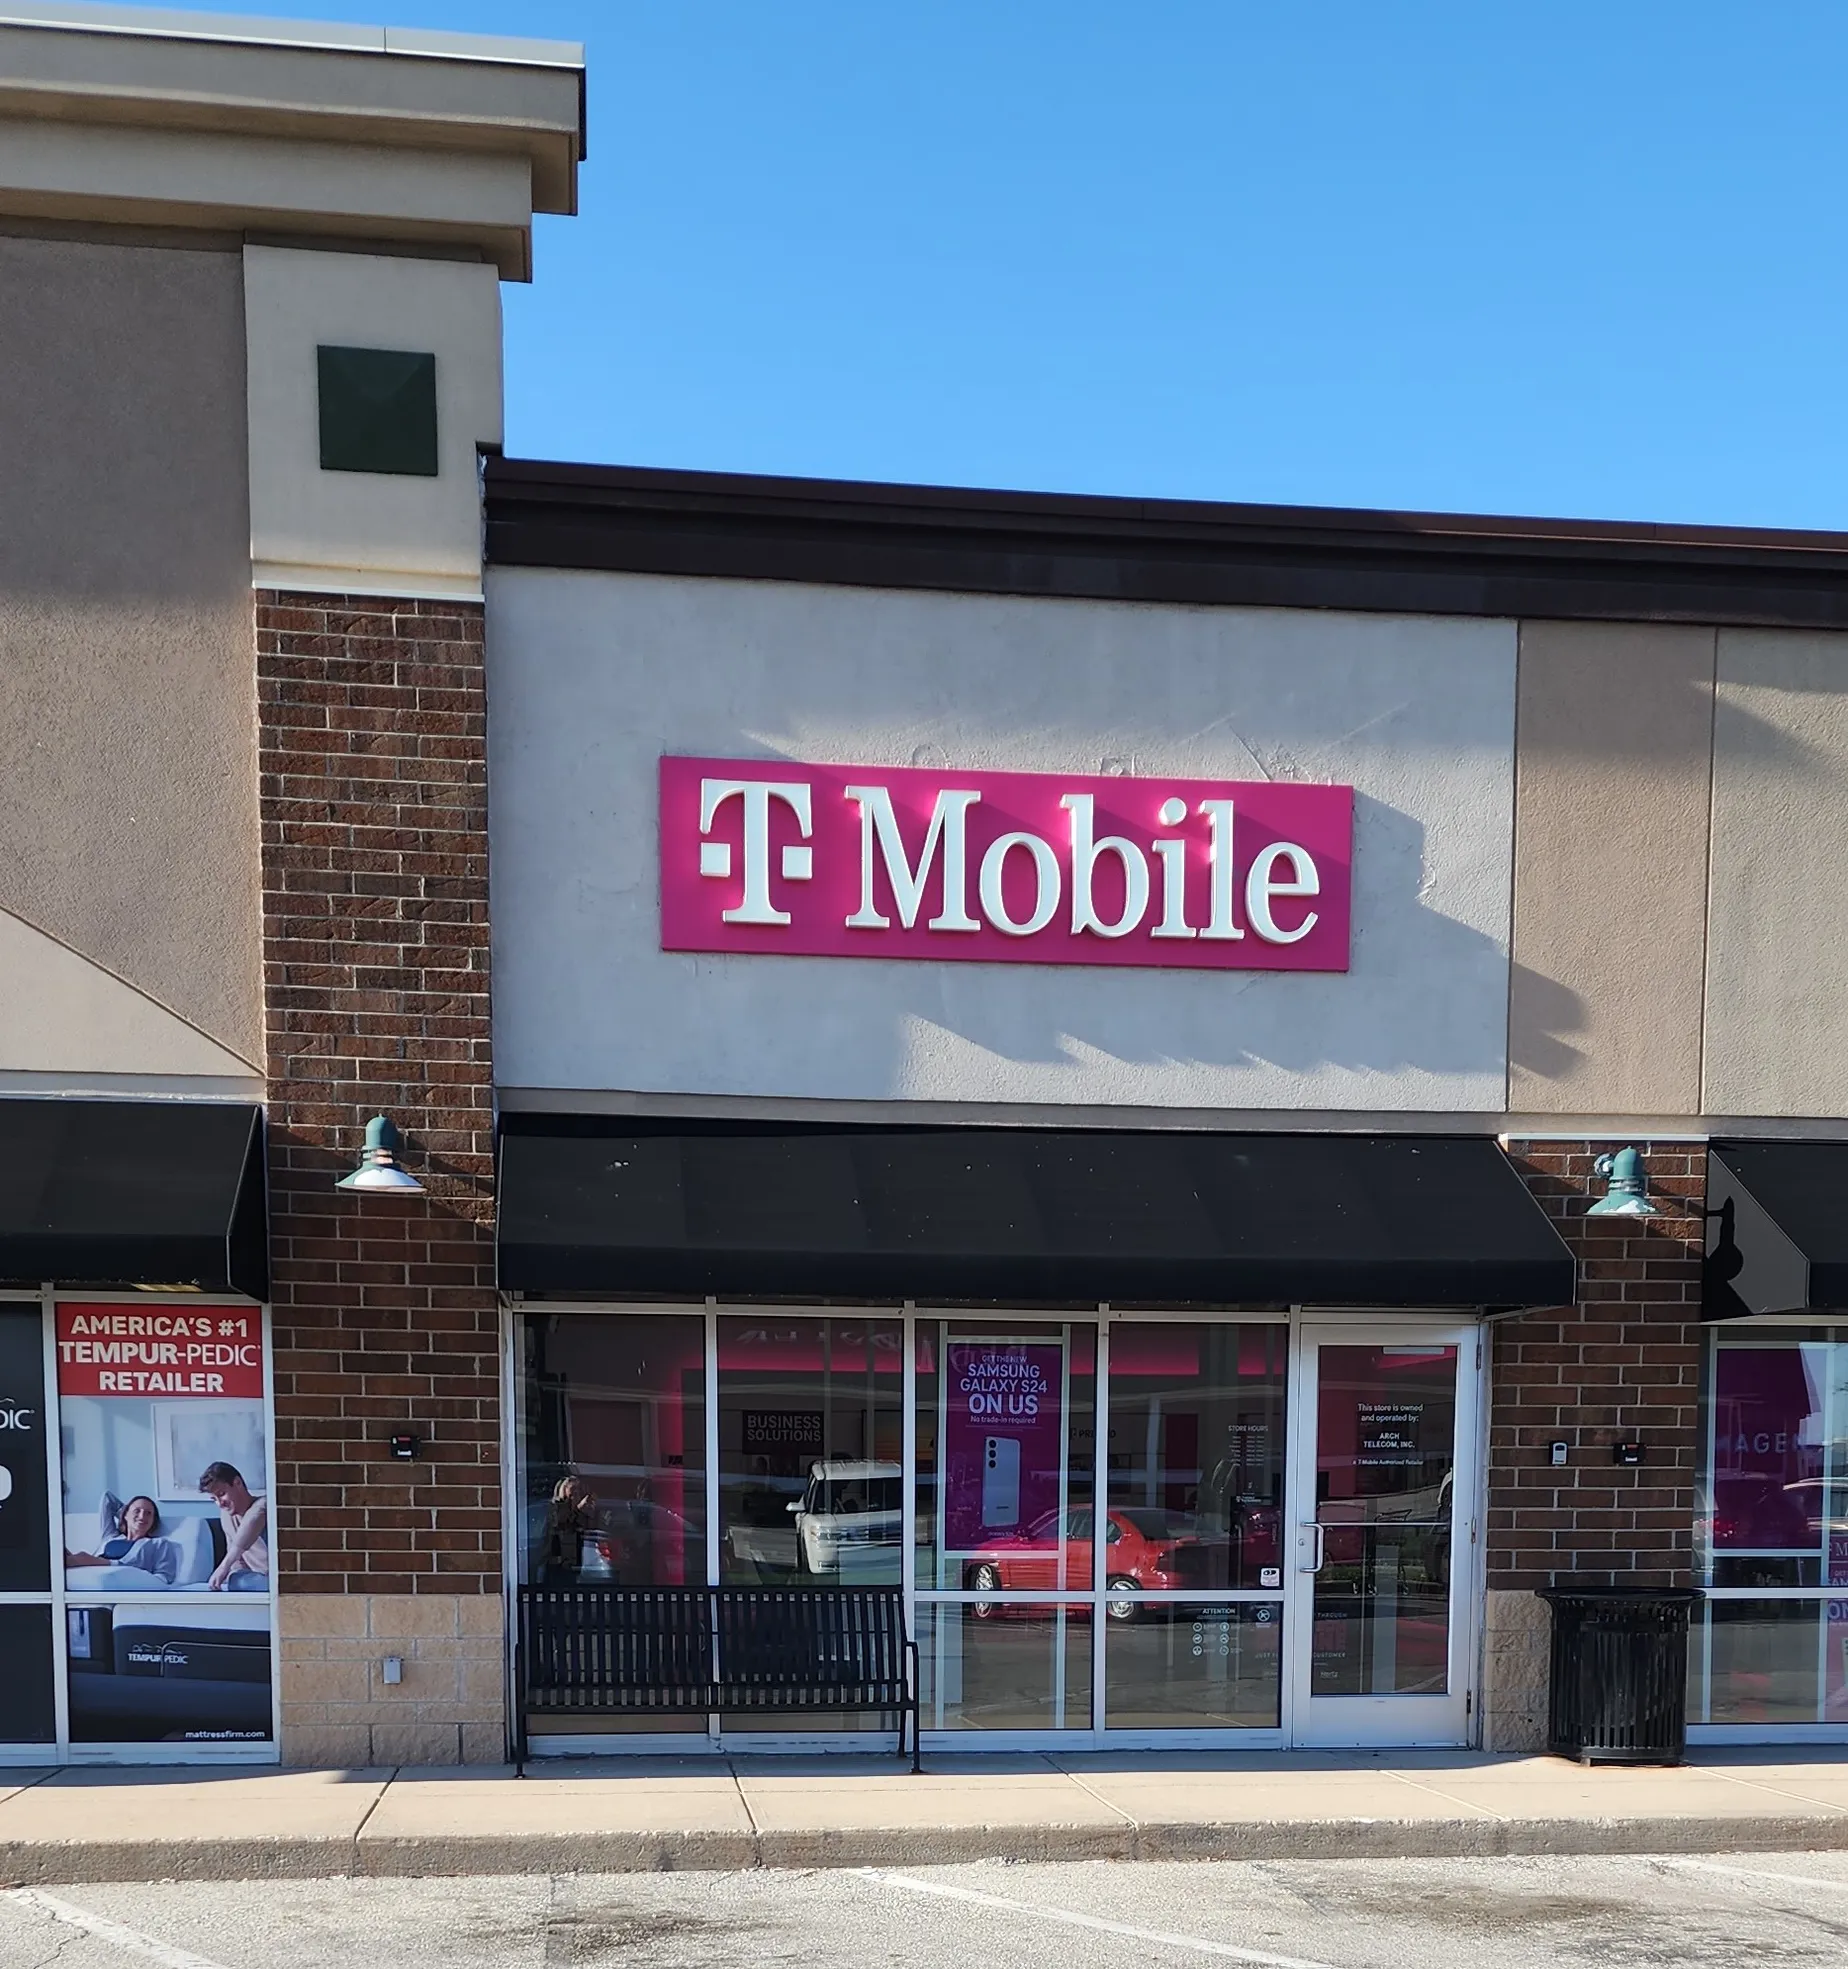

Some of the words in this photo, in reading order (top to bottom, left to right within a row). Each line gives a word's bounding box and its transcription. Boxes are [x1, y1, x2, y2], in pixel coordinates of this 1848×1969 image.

[844, 785, 1320, 945] Mobile
[70, 1314, 212, 1337] AMERICA'S
[217, 1318, 248, 1338] #1
[58, 1341, 259, 1367] TEMPUR-PEDIC
[967, 1363, 1041, 1378] SAMSUNG
[99, 1371, 225, 1393] RETAILER
[960, 1378, 1019, 1393] GALAXY
[1021, 1379, 1048, 1393] S24
[969, 1393, 1003, 1414] ON
[1008, 1394, 1040, 1415] US
[1357, 1403, 1373, 1412] This
[1373, 1404, 1392, 1412] store
[1392, 1404, 1399, 1412] is
[1399, 1403, 1424, 1412] owned
[747, 1414, 821, 1430] BUSINESS
[970, 1415, 981, 1423] No
[981, 1415, 1008, 1424] trade-in
[1008, 1416, 1037, 1425] required
[1361, 1413, 1375, 1422] and
[1375, 1413, 1408, 1424] operated
[1408, 1413, 1420, 1423] by:
[1228, 1424, 1247, 1432] STORE
[1247, 1424, 1269, 1432] HOURS
[747, 1429, 822, 1442] SOLUTIONS
[1379, 1432, 1400, 1440] ARCH
[1363, 1440, 1400, 1449] TELECOM,
[1400, 1440, 1416, 1449] INC.
[1202, 1607, 1236, 1615] ATTENTION
[185, 1730, 266, 1739] mattressfirm.com
